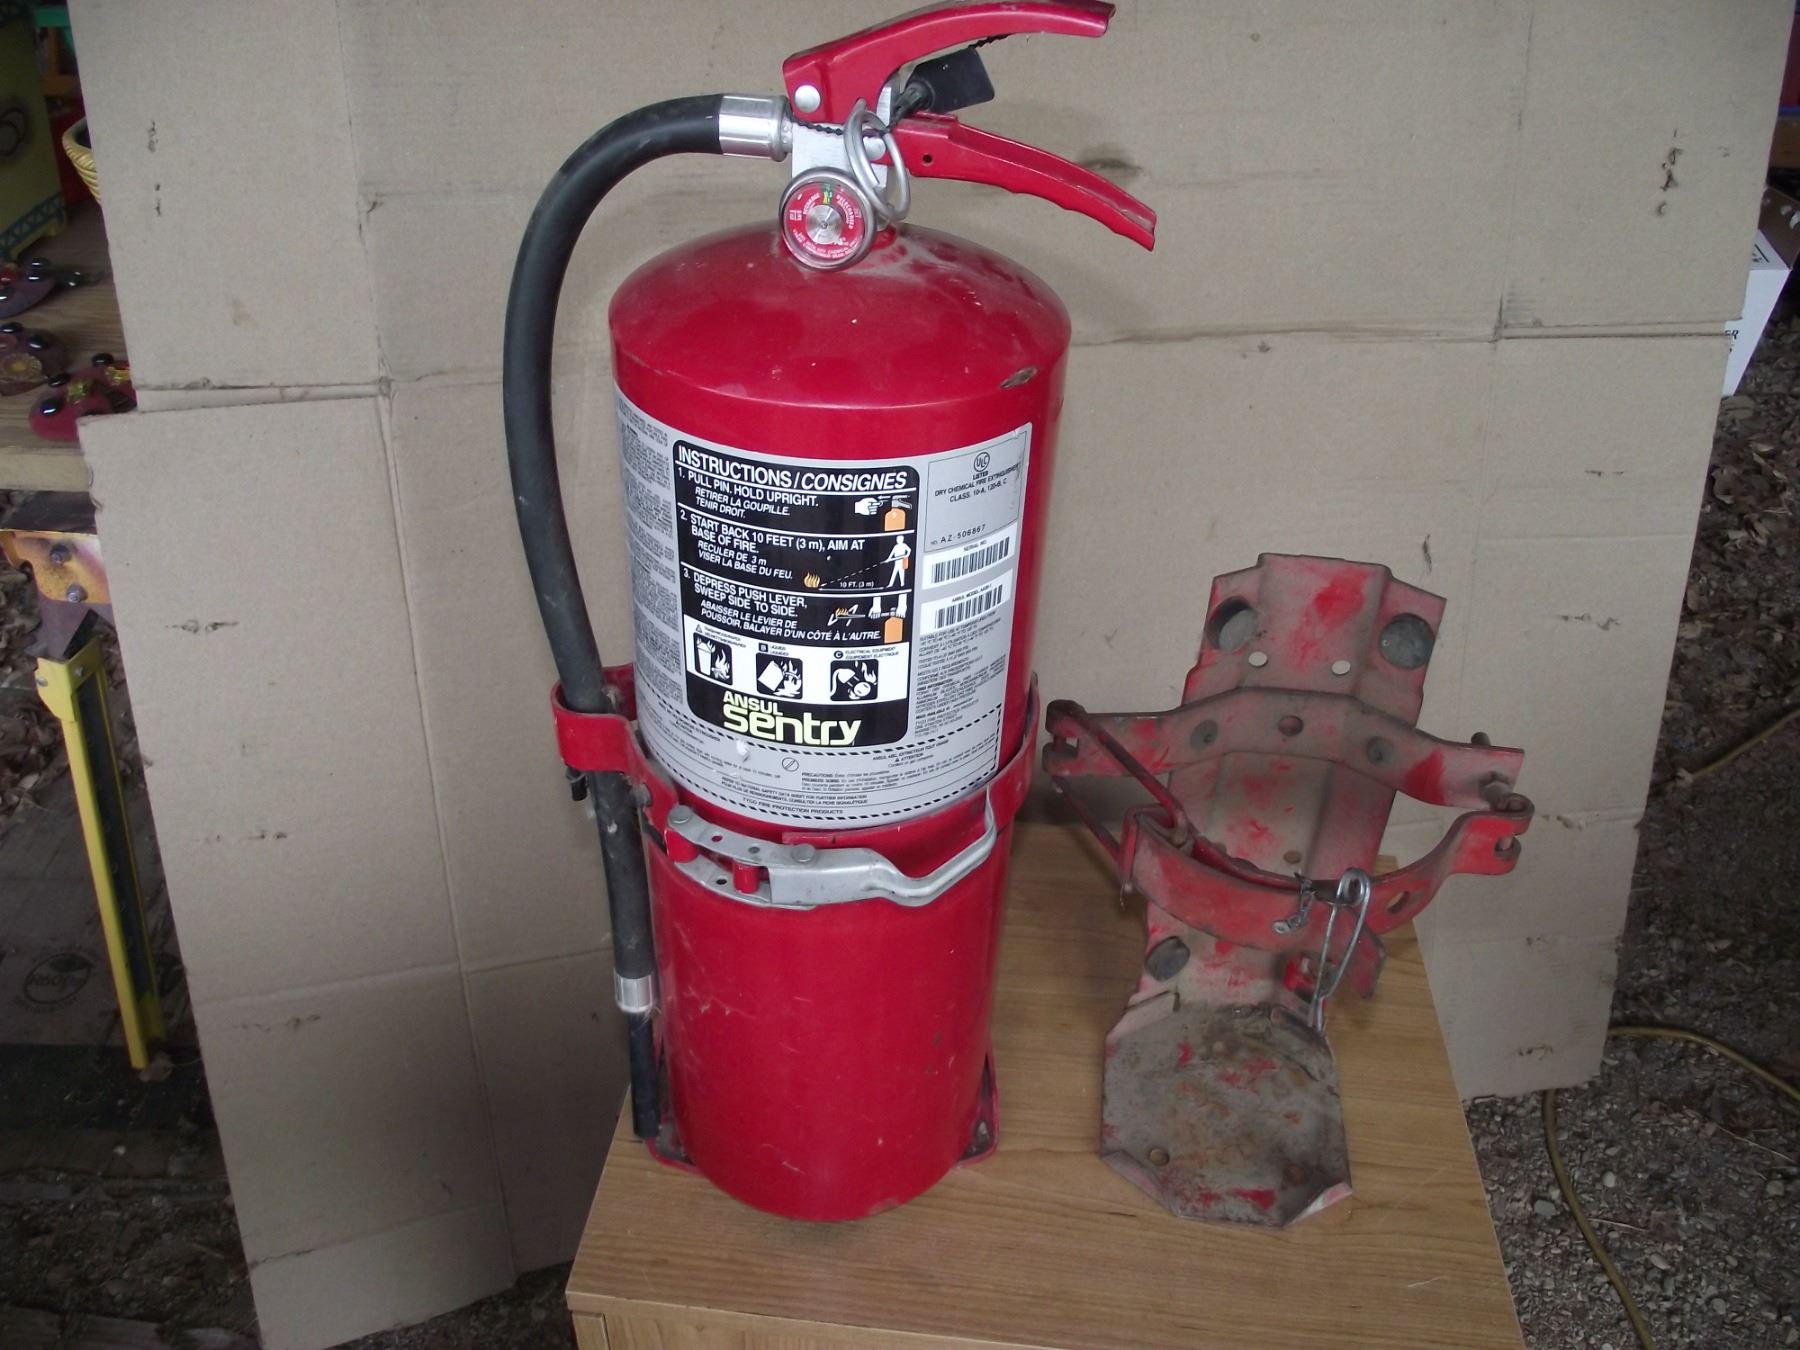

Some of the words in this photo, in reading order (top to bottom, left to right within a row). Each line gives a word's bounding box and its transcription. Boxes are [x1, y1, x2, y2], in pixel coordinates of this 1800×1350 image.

[678, 466, 686, 479] 1.
[688, 470, 712, 489] PULL
[714, 480, 732, 495] PIN.
[734, 485, 764, 502] HOLD
[766, 492, 819, 507] UPRIGHT.
[695, 487, 729, 505] RETIRER
[730, 496, 741, 508] LA
[935, 487, 947, 497] DRY
[948, 481, 975, 494] CHEMICAL
[680, 508, 688, 521] 2.
[696, 496, 718, 513] TENIR
[719, 503, 746, 519] DROIT.
[690, 513, 719, 533] START
[721, 522, 750, 540] BACK
[752, 531, 764, 543] 10
[766, 534, 794, 548] FEET
[827, 539, 848, 551] AIM
[850, 539, 865, 551] AT
[691, 525, 717, 543] BASE
[718, 533, 732, 547] OF
[733, 537, 759, 554] FIRE.
[698, 541, 734, 560] RECULER
[735, 549, 749, 562] DE
[751, 555, 758, 564] 3
[759, 558, 767, 566] m
[698, 550, 720, 566] VISER
[721, 556, 732, 568] LA
[734, 559, 758, 574] BASE
[759, 566, 772, 577] DU
[773, 567, 793, 580] FEU.
[683, 567, 691, 580] 3.
[693, 572, 737, 595] DEPRESS
[738, 585, 768, 601] PUSH
[769, 590, 808, 609] LEVER,
[694, 583, 727, 602] SWEEP
[728, 594, 751, 609] SIDE
[754, 602, 767, 613] TO
[768, 603, 798, 618] SIDE.
[700, 600, 739, 619] ABAISSER
[740, 611, 751, 622] LE
[752, 614, 783, 629] LEVIER
[785, 620, 798, 630] DE
[701, 608, 742, 631] POUSSOIR,
[743, 619, 782, 637] BALAYER
[784, 627, 806, 640] D'UN
[806, 629, 833, 641] CÔTÉ
[833, 630, 840, 641] À
[723, 691, 783, 716] ANSUL
[723, 704, 862, 746] sentry
